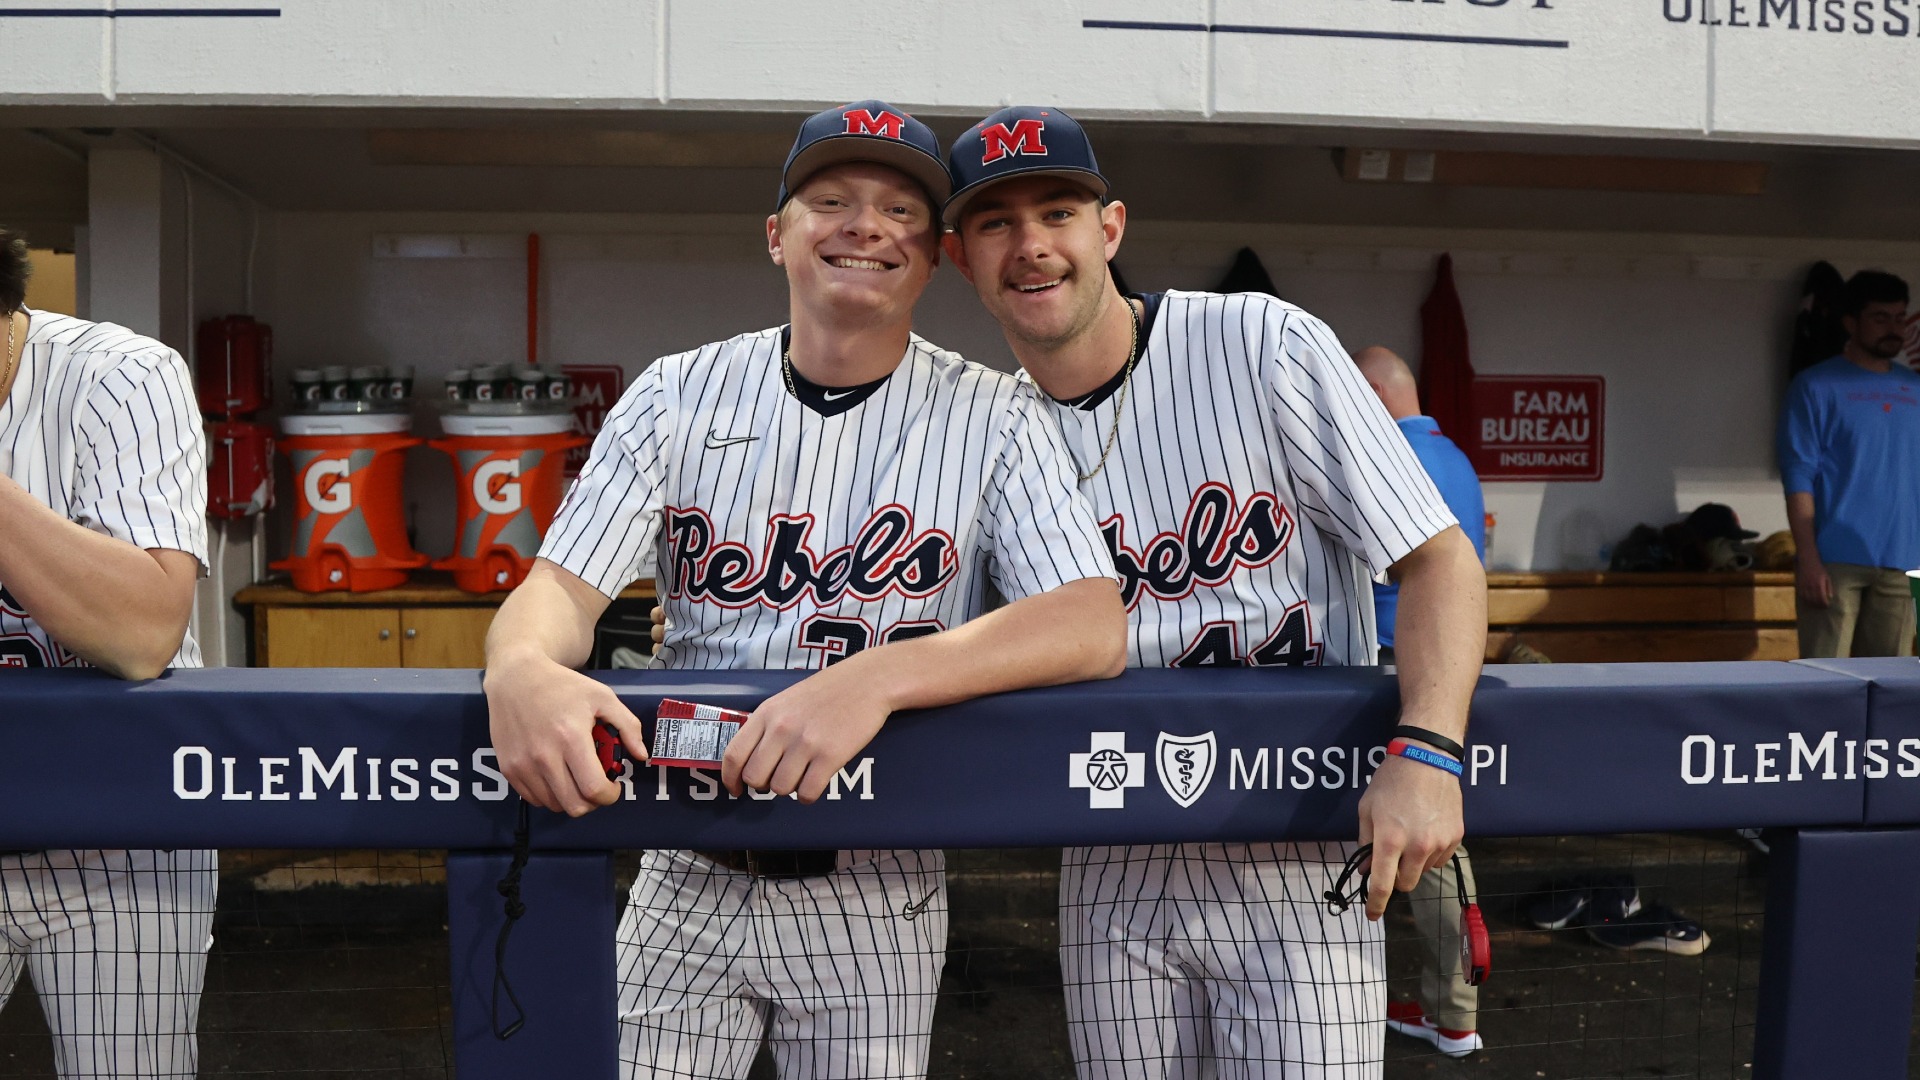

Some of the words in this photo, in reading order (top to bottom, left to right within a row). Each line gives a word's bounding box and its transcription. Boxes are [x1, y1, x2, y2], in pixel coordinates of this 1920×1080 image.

[1663, 0, 1920, 37] OLEMISSS
[843, 109, 904, 140] M
[980, 118, 1048, 166] M
[1513, 390, 1589, 414] FARM
[1481, 418, 1590, 442] BUREAU
[1500, 452, 1589, 466] INSURANCE
[304, 458, 352, 514] G
[472, 458, 522, 514] G
[666, 503, 960, 611] Rebels
[1098, 481, 1295, 614] bels
[656, 719, 664, 733] Facts
[653, 734, 662, 757] Nutrition
